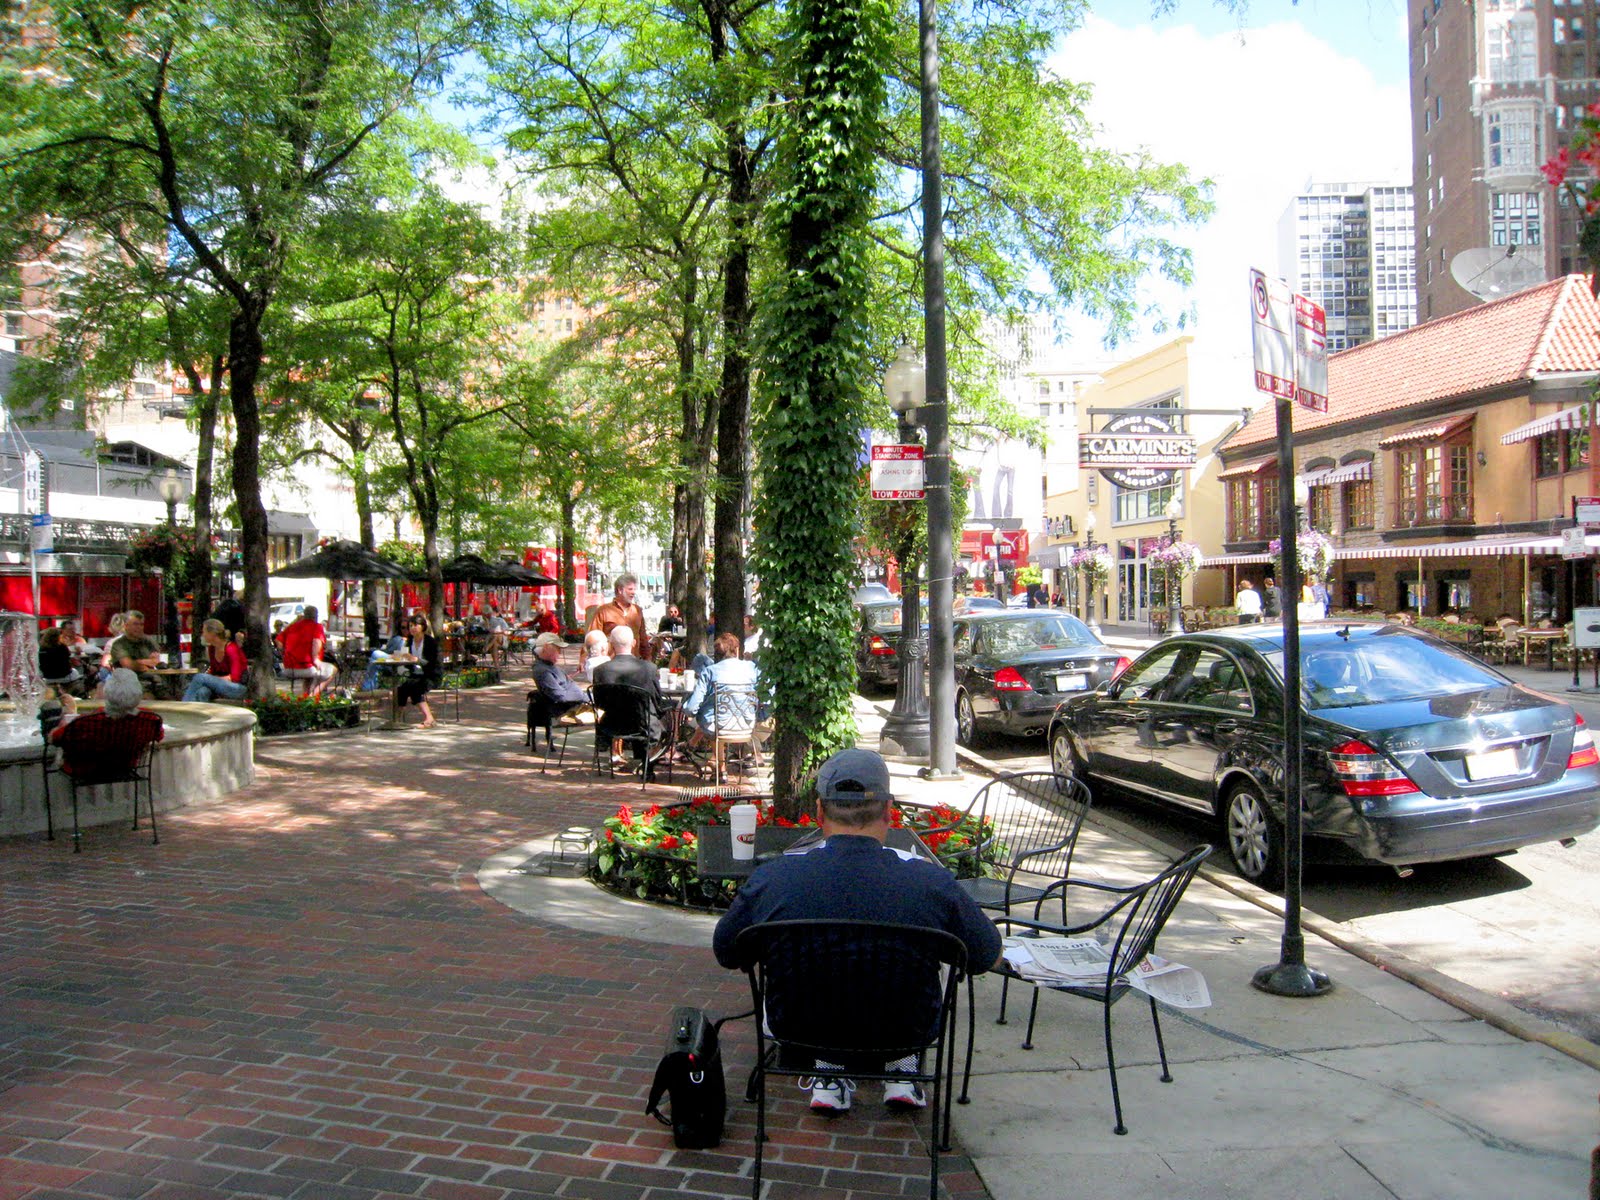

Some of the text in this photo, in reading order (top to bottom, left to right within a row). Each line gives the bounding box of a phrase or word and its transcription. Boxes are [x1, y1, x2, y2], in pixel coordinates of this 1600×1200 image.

[1257, 372, 1292, 397] TOW ZONE
[1300, 390, 1327, 413] TOW ZONE
[1130, 425, 1150, 433] BAR
[1088, 439, 1192, 455] CARMINE'S
[1138, 455, 1192, 463] RESTAURANT
[1113, 471, 1168, 487] SPAGHETTI
